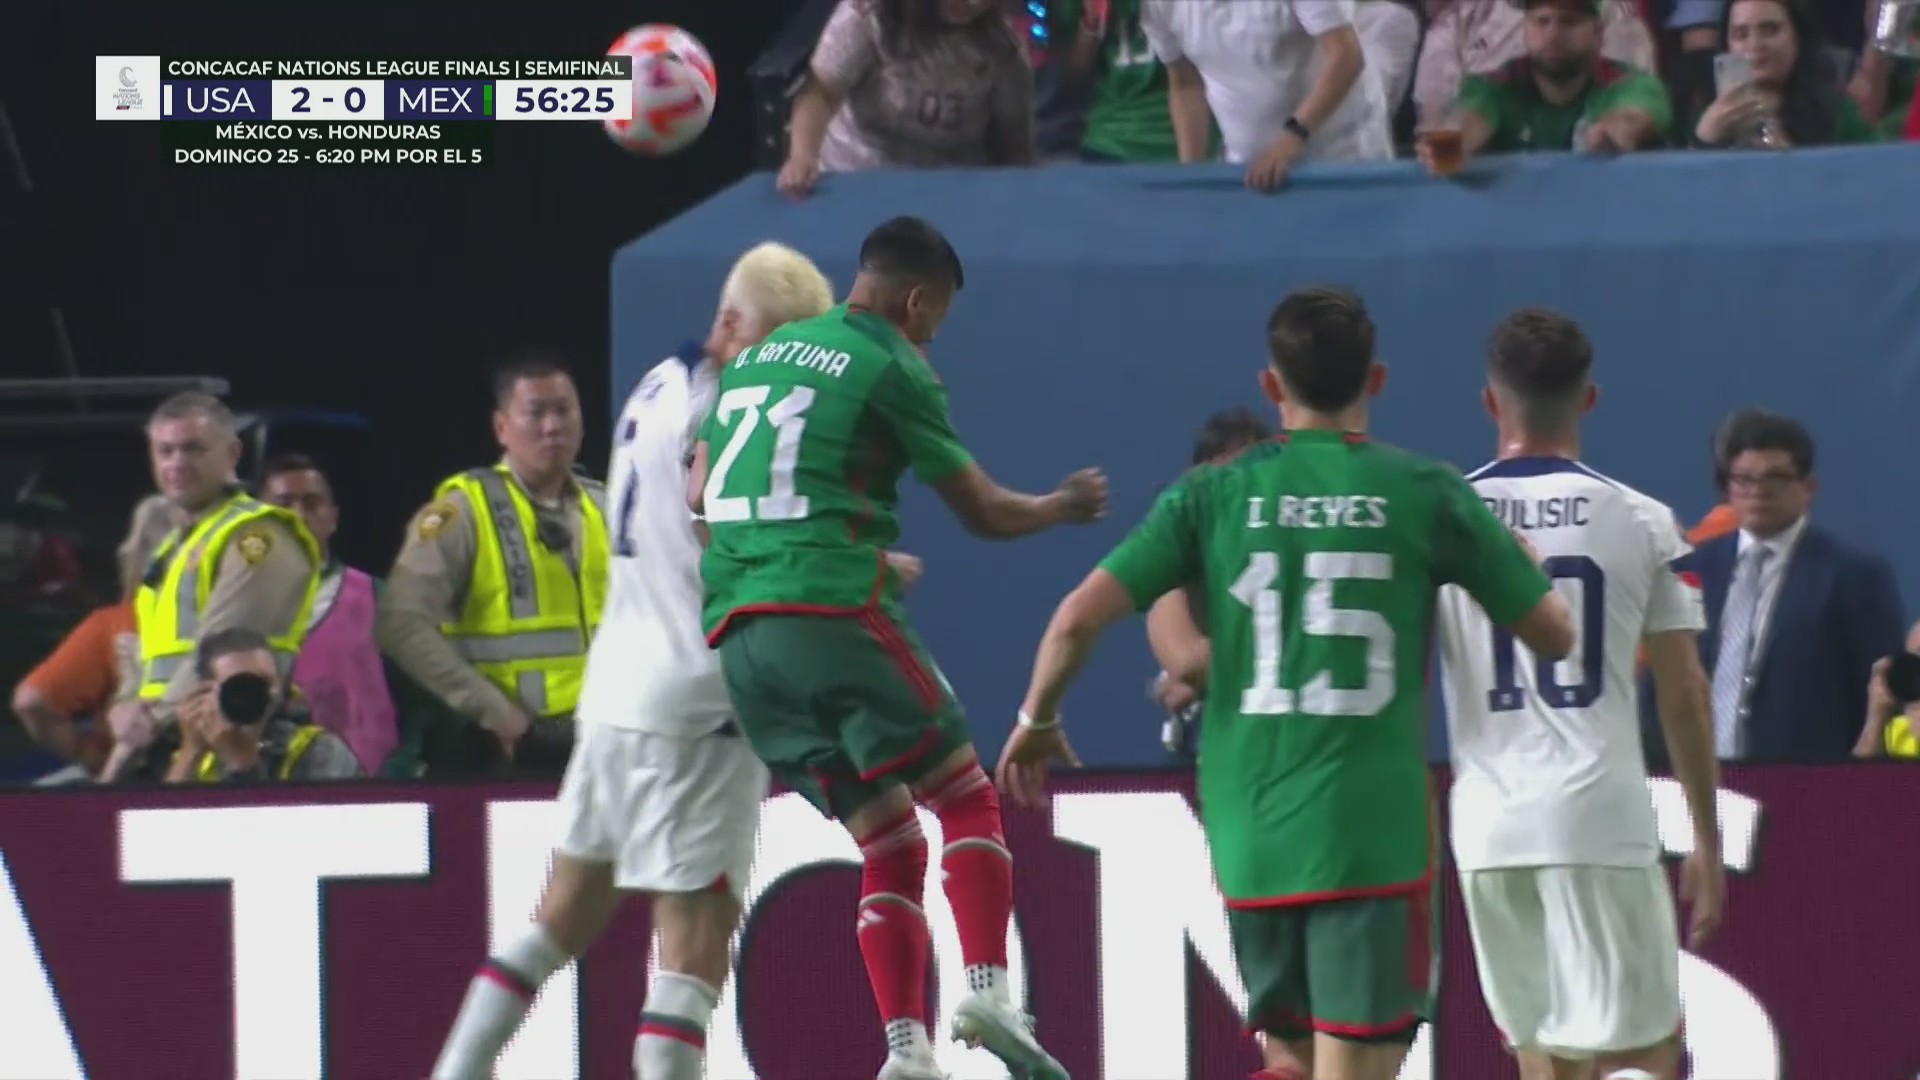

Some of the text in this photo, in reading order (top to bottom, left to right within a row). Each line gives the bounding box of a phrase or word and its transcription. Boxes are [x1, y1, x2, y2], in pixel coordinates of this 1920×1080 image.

[755, 341, 852, 378] ANTUNA
[703, 384, 816, 523] 21
[1276, 494, 1389, 529] REYES
[1227, 550, 1397, 717] 15
